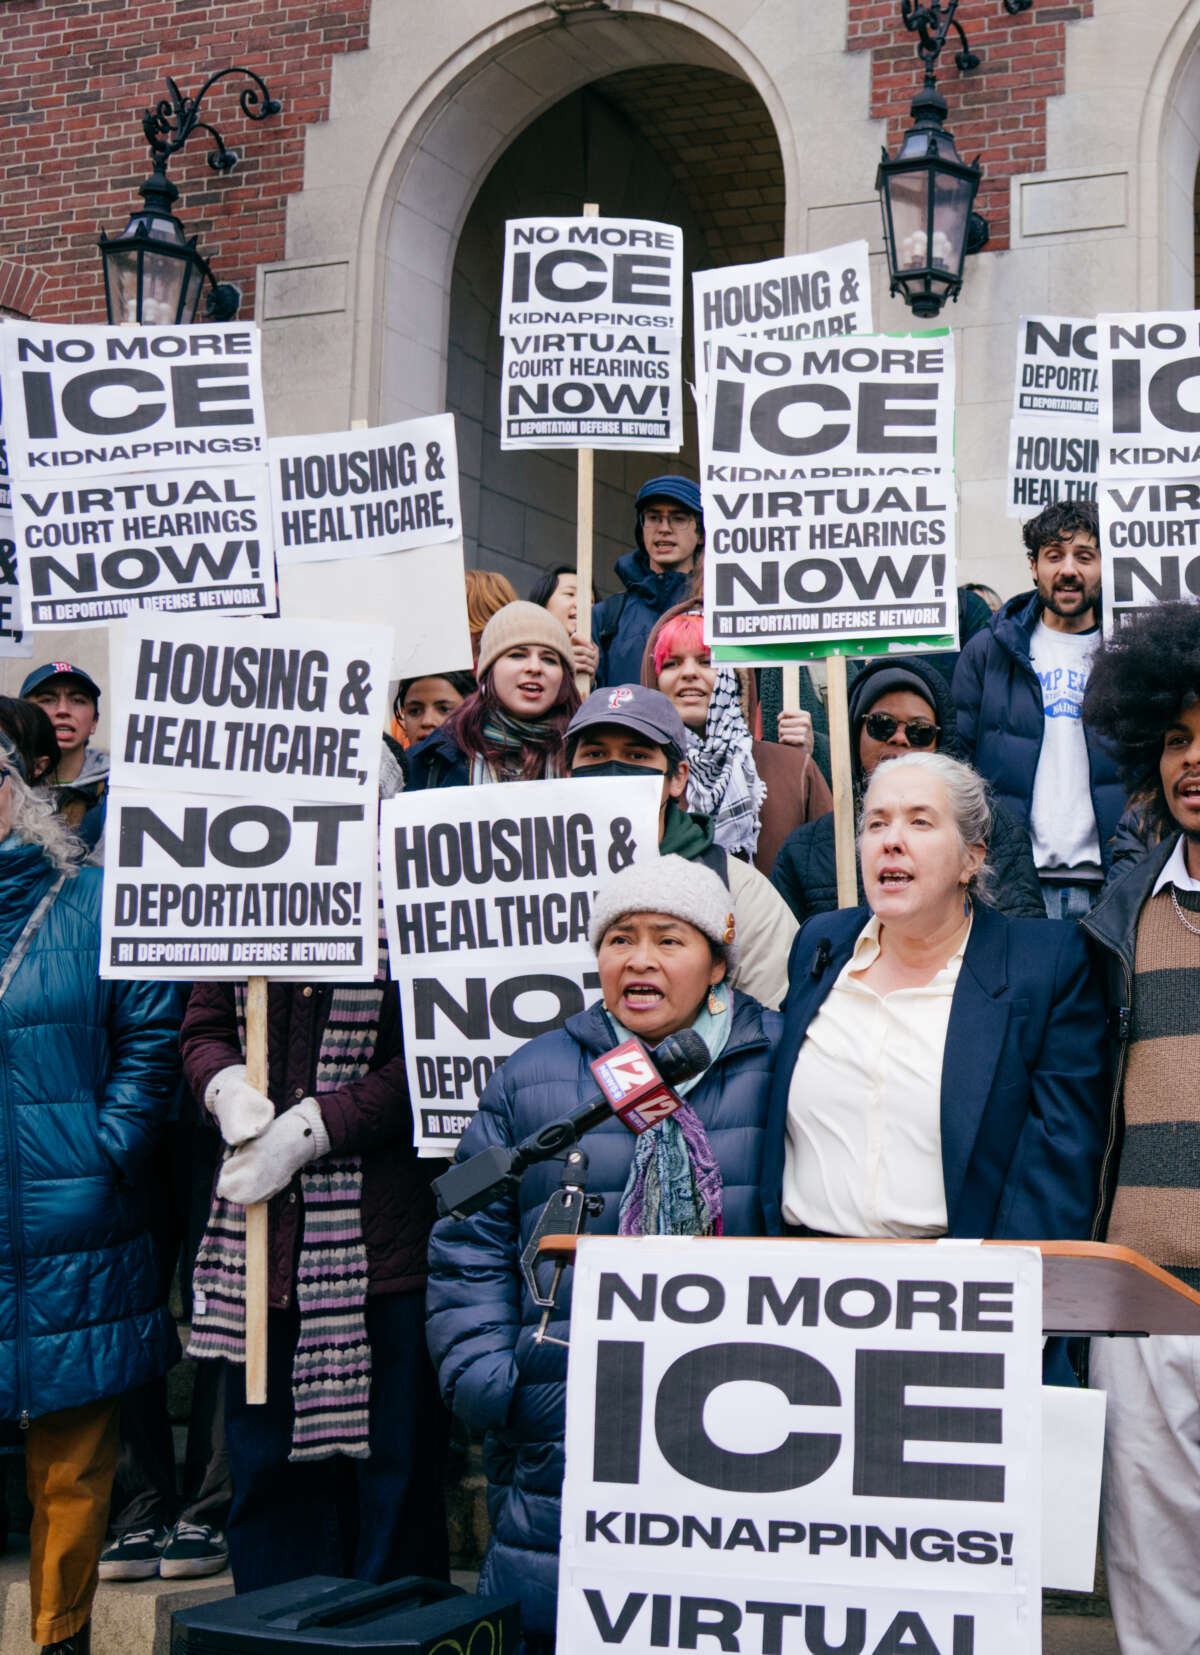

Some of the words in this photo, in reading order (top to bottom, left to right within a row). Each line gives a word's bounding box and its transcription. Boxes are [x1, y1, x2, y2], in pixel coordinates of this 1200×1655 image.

[513, 226, 559, 246] NO
[567, 226, 674, 251] MORE
[511, 249, 672, 307] ICE
[703, 270, 831, 331] HOUSING
[840, 267, 861, 305] &
[508, 311, 674, 329] KIDNAPPINGS!
[1109, 322, 1186, 350] NO
[17, 337, 95, 363] NO
[106, 332, 252, 361] MORE
[511, 332, 670, 356] VIRTUAL
[1024, 320, 1098, 360] NO
[508, 357, 562, 379] COURT
[569, 357, 670, 380] HEARINGS
[716, 345, 792, 377] NO
[802, 347, 945, 375] MORE
[1022, 363, 1099, 392] DEPORTA
[22, 362, 255, 439] ICE
[508, 382, 670, 417] NOW!
[711, 379, 939, 457] ICE
[1032, 396, 1083, 411] DEPORTATION
[521, 421, 578, 435] DEPORTATION
[579, 421, 620, 435] DEFENSE
[621, 422, 666, 436] NETWORK
[27, 436, 262, 468] KIDNAPPINGS!
[280, 442, 417, 501] HOUSING
[425, 440, 446, 481] &
[1016, 436, 1099, 474] HOUSI
[21, 479, 256, 517] VIRTUAL
[712, 486, 947, 520] VIRTUAL
[1013, 477, 1099, 506] HEALTH
[24, 519, 113, 549] COURT
[123, 509, 258, 542] HEARINGS
[281, 490, 454, 546] HEALTHCARE,
[712, 525, 801, 555] COURT
[808, 519, 947, 551] HEARINGS
[1109, 518, 1200, 549] COURT
[29, 540, 261, 597] NOW!
[714, 554, 947, 607] NOW!
[38, 605, 53, 621] RI
[55, 597, 141, 621] DEPORTATION
[144, 592, 196, 611] DEFENSE
[198, 588, 261, 607] NETWORK
[719, 616, 733, 634] RI
[736, 612, 819, 633] DEPORTATION
[822, 610, 876, 630] DEFENSE
[879, 607, 940, 628] NETWORK
[134, 639, 330, 713] HOUSING
[339, 659, 373, 716] &
[123, 713, 368, 786] HEALTHCARE,
[118, 804, 365, 869] NOT
[394, 812, 598, 890] HOUSING
[607, 815, 638, 874] &
[113, 881, 362, 928] DEPORTATIONS!
[396, 890, 600, 955] HEALTHCA
[118, 943, 135, 962] RI
[137, 942, 229, 963] DEPORTATION
[231, 942, 289, 962] DEFENSE
[291, 942, 356, 962] NETWORK
[427, 1115, 440, 1133] RI
[596, 1272, 727, 1325] NO
[746, 1275, 1015, 1333] MORE
[592, 1339, 1006, 1503] ICE
[584, 1509, 1014, 1566] KIDNAPPINGS!
